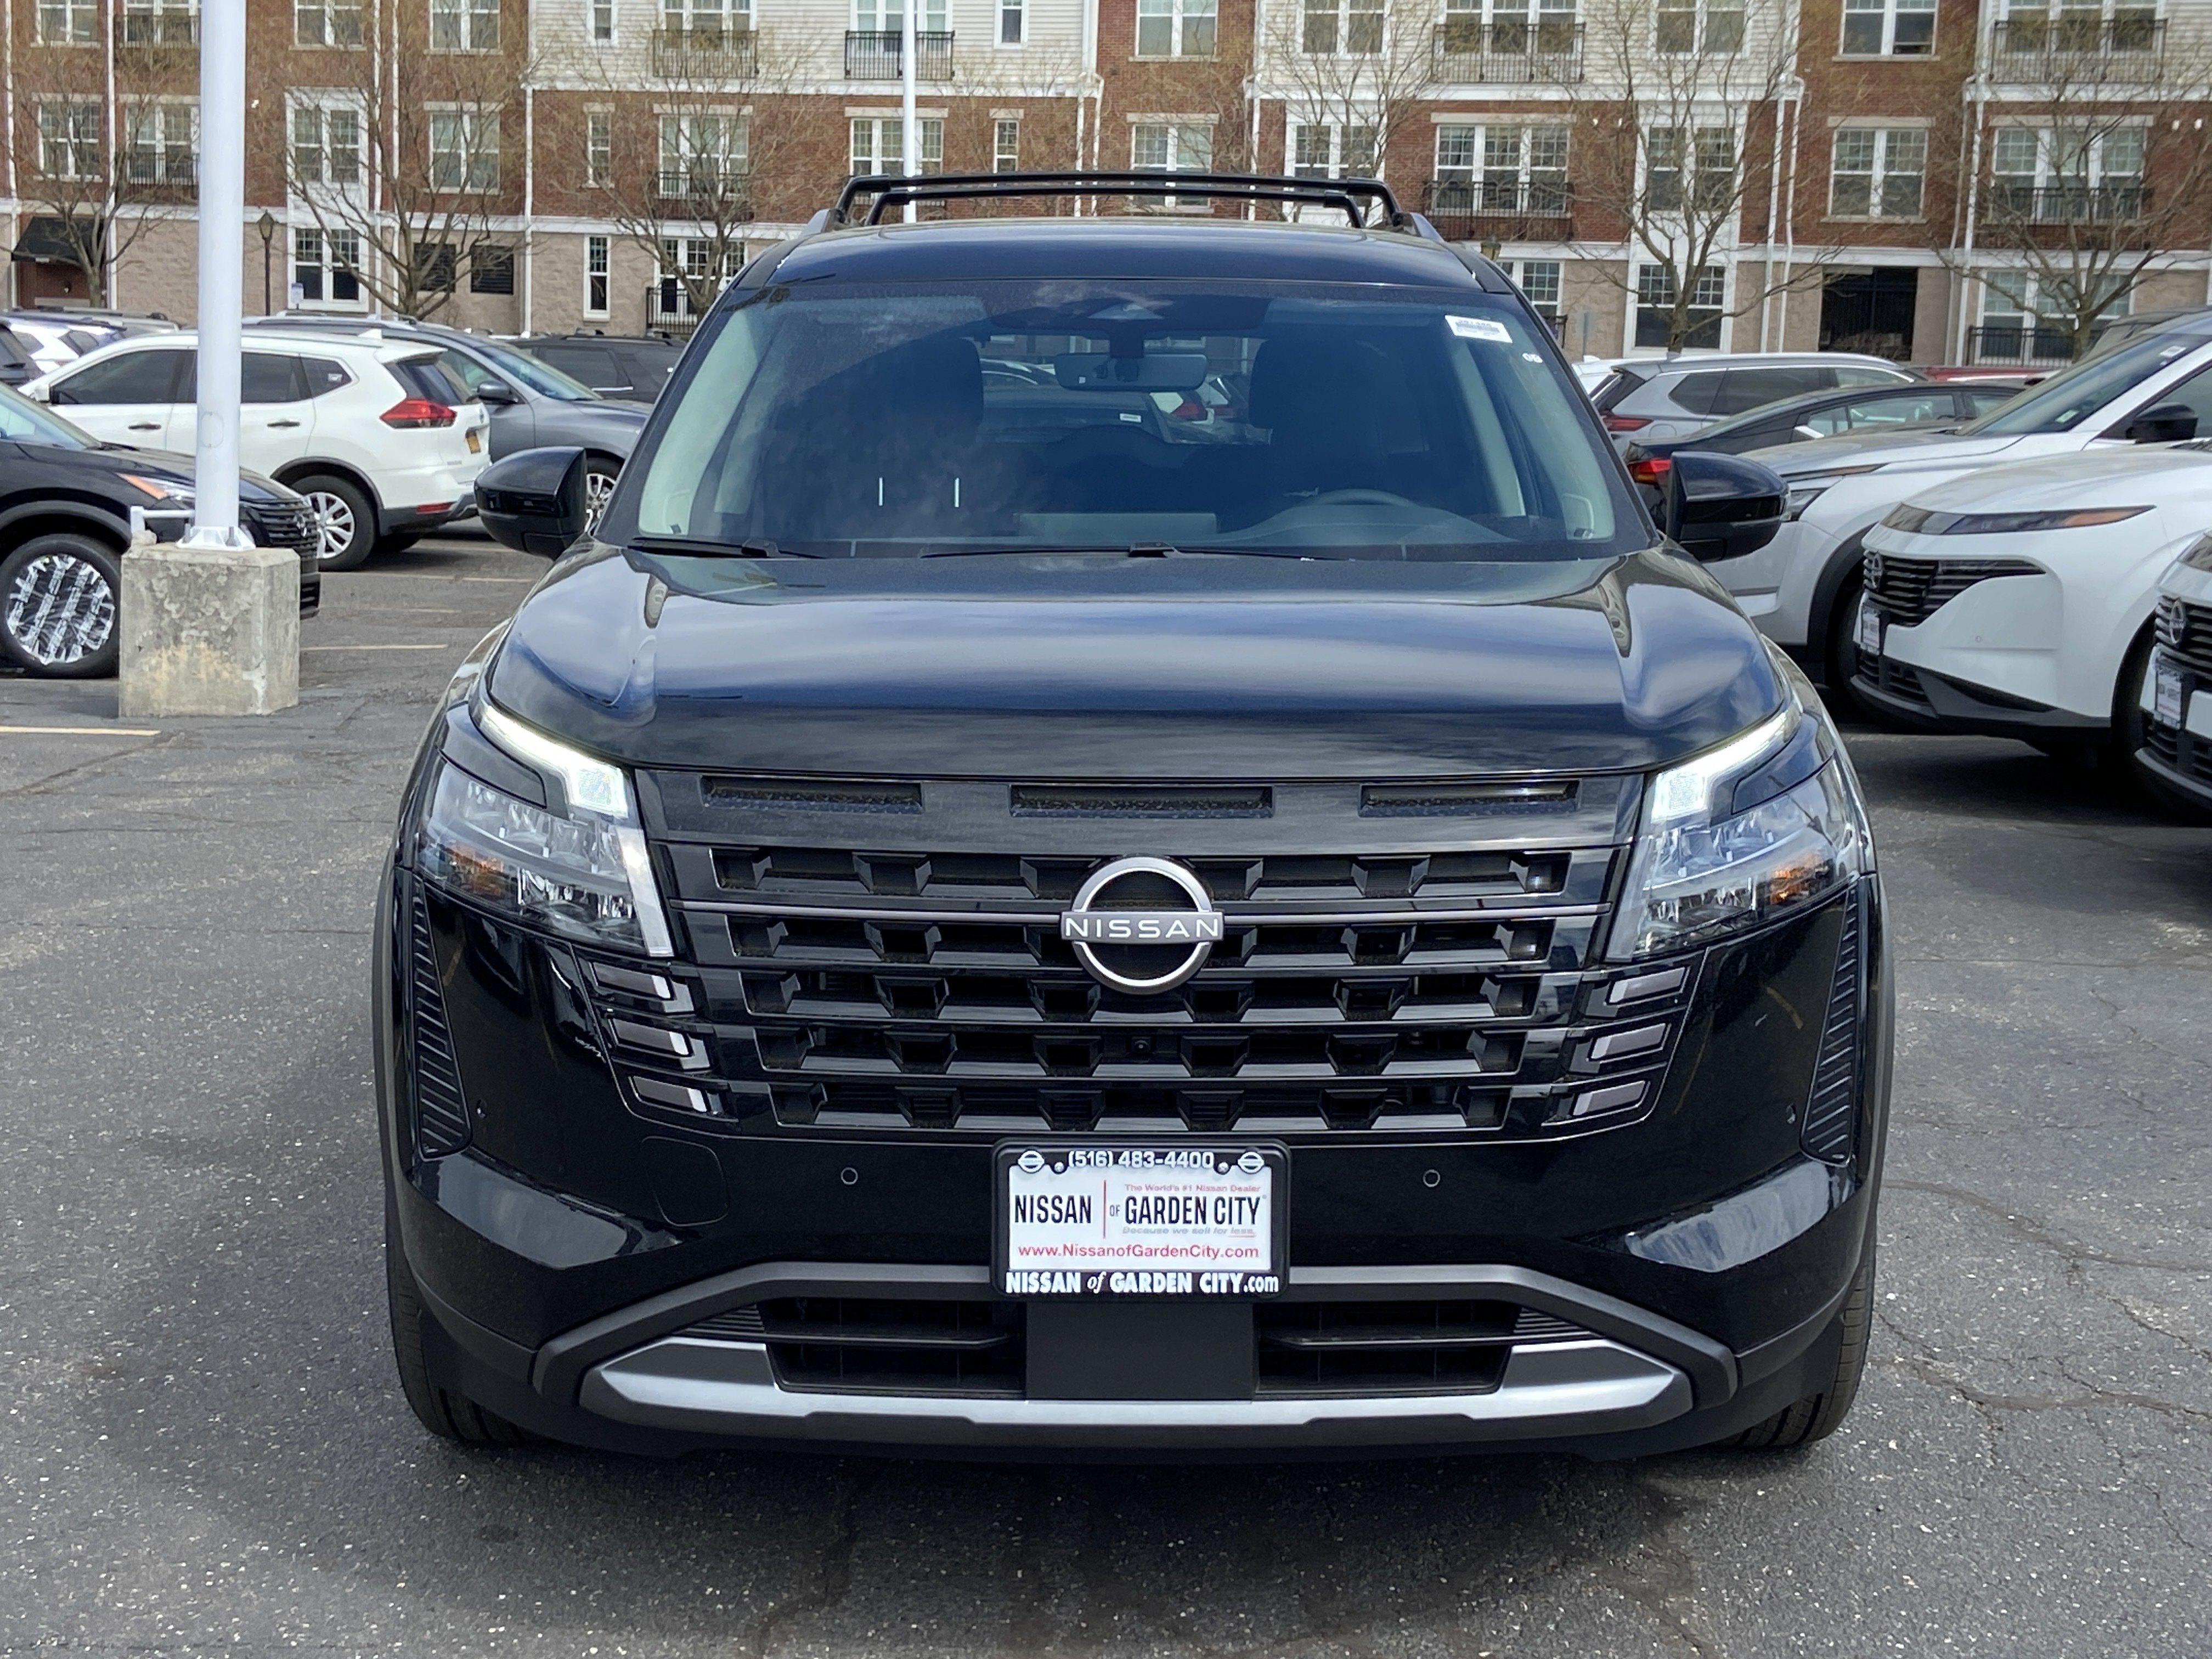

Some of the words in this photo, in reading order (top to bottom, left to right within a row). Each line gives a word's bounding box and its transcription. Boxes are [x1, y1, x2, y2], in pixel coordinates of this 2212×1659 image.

[1065, 918, 1218, 938] NISSAN
[1068, 1150, 1114, 1168] (516)
[1118, 1150, 1215, 1169] 483-4400
[1014, 1194, 1092, 1223] NISSAN
[1109, 1204, 1120, 1216] OF
[1125, 1195, 1207, 1225] GARDEN
[1214, 1195, 1261, 1225] CITY
[1122, 1226, 1169, 1234] Because
[1018, 1243, 1259, 1260] www.NissanofGardenCity.com
[1005, 1271, 1081, 1294] NISSAN
[1087, 1271, 1107, 1294] of
[1109, 1271, 1193, 1294] GARDEN
[1199, 1272, 1279, 1294] CITY.com
